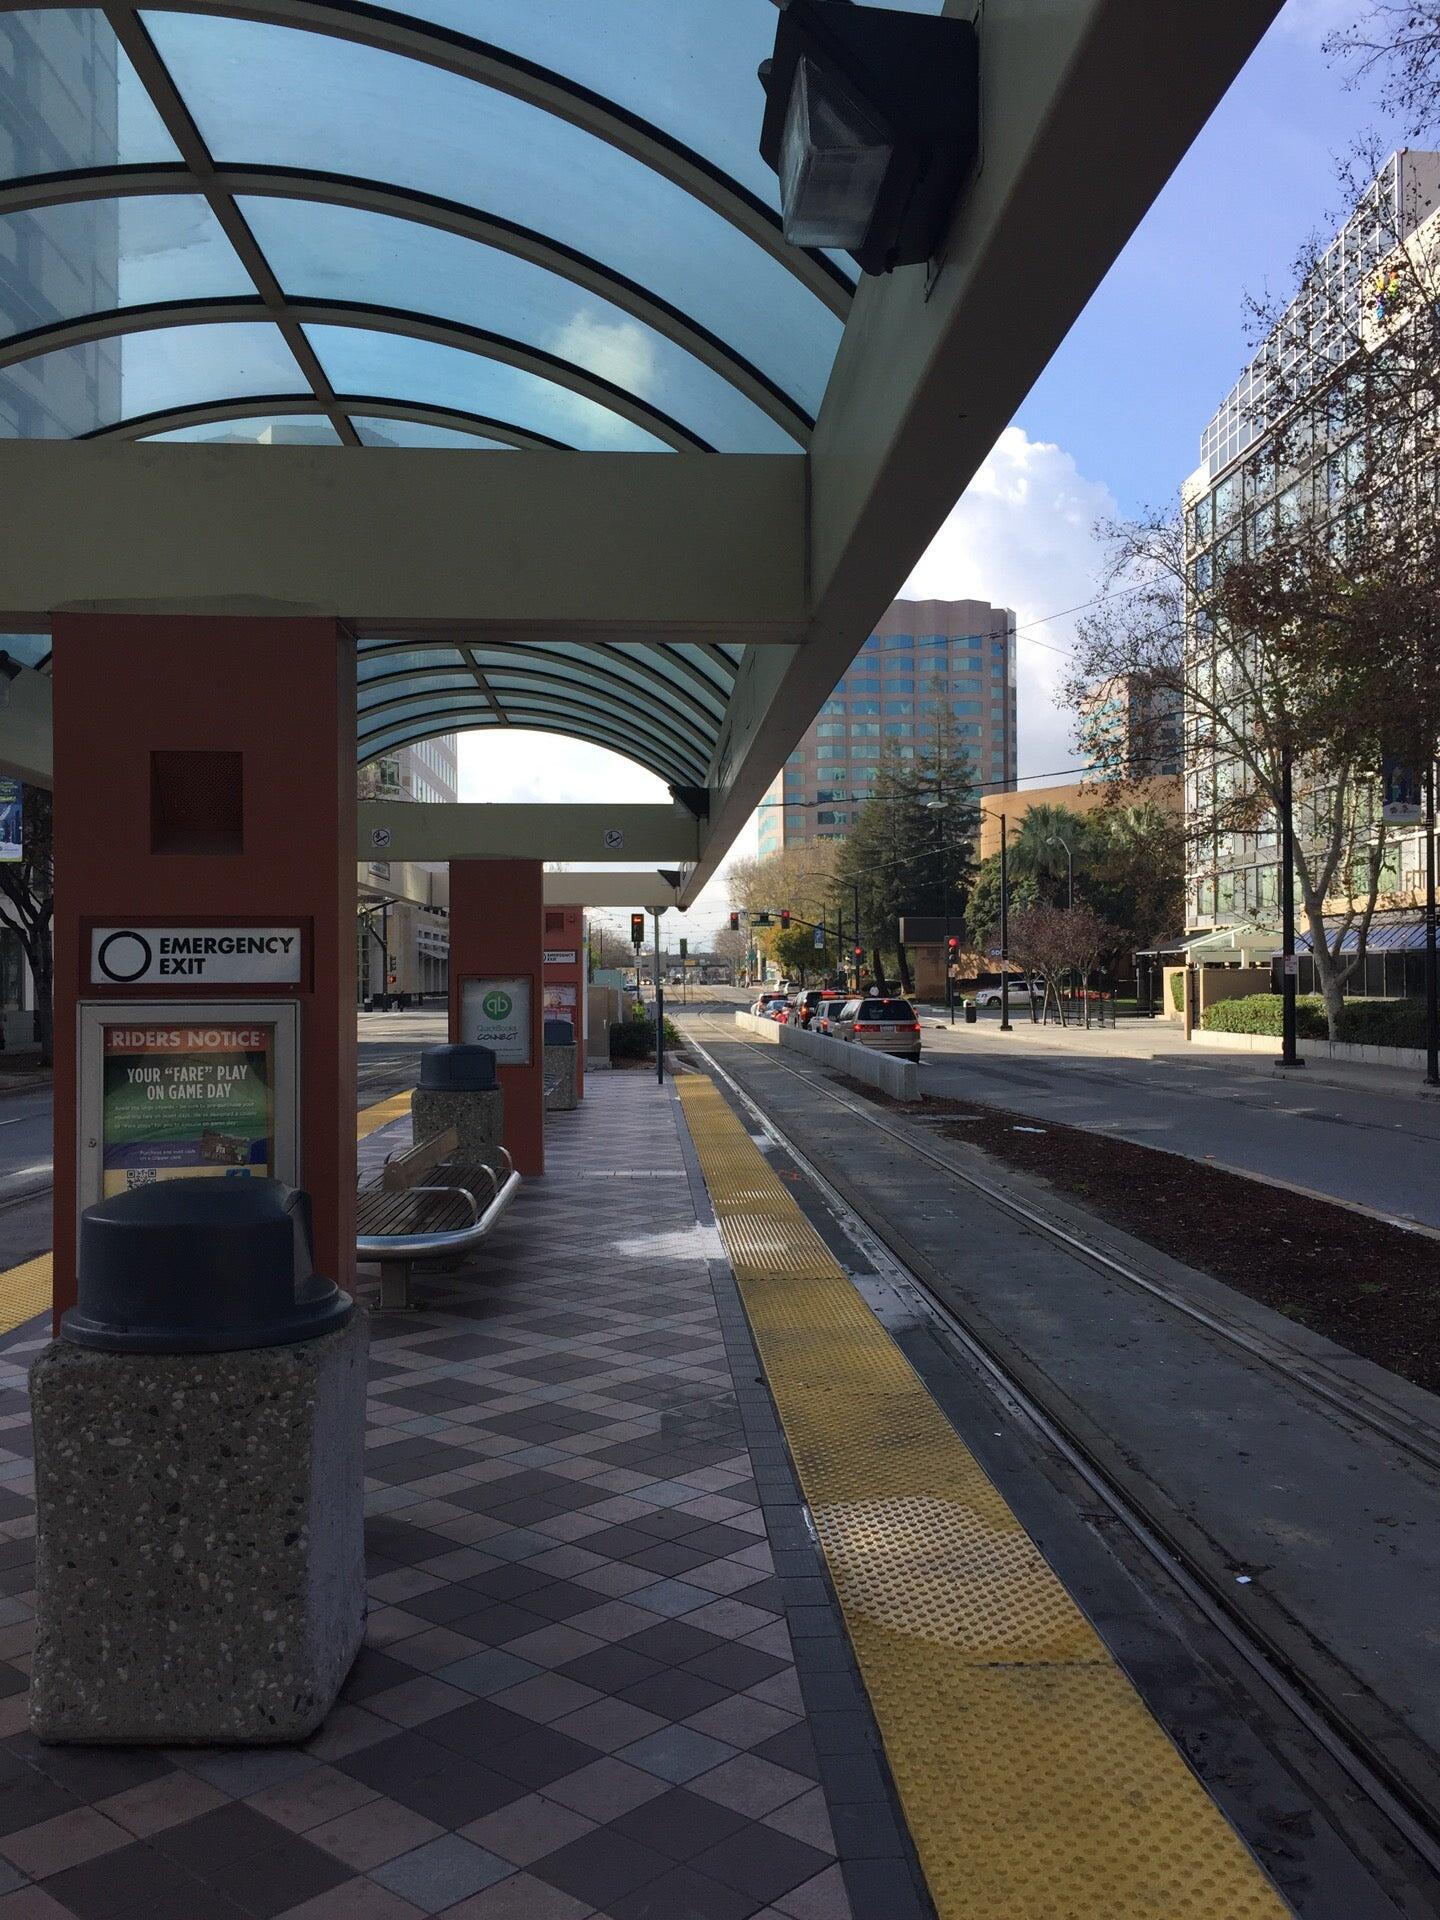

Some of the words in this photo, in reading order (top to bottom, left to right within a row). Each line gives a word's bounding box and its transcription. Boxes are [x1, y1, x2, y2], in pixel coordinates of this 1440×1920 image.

[159, 936, 294, 954] EMERGENCY
[159, 957, 206, 975] EXIT
[112, 1031, 181, 1047] RIDERS
[188, 1030, 260, 1047] NOTICE
[477, 1032, 518, 1041] CONNECT
[127, 1067, 161, 1084] YOUR
[217, 1064, 248, 1081] PLAY
[147, 1085, 164, 1100] ON
[168, 1084, 203, 1099] GAME
[207, 1083, 232, 1098] DAY
